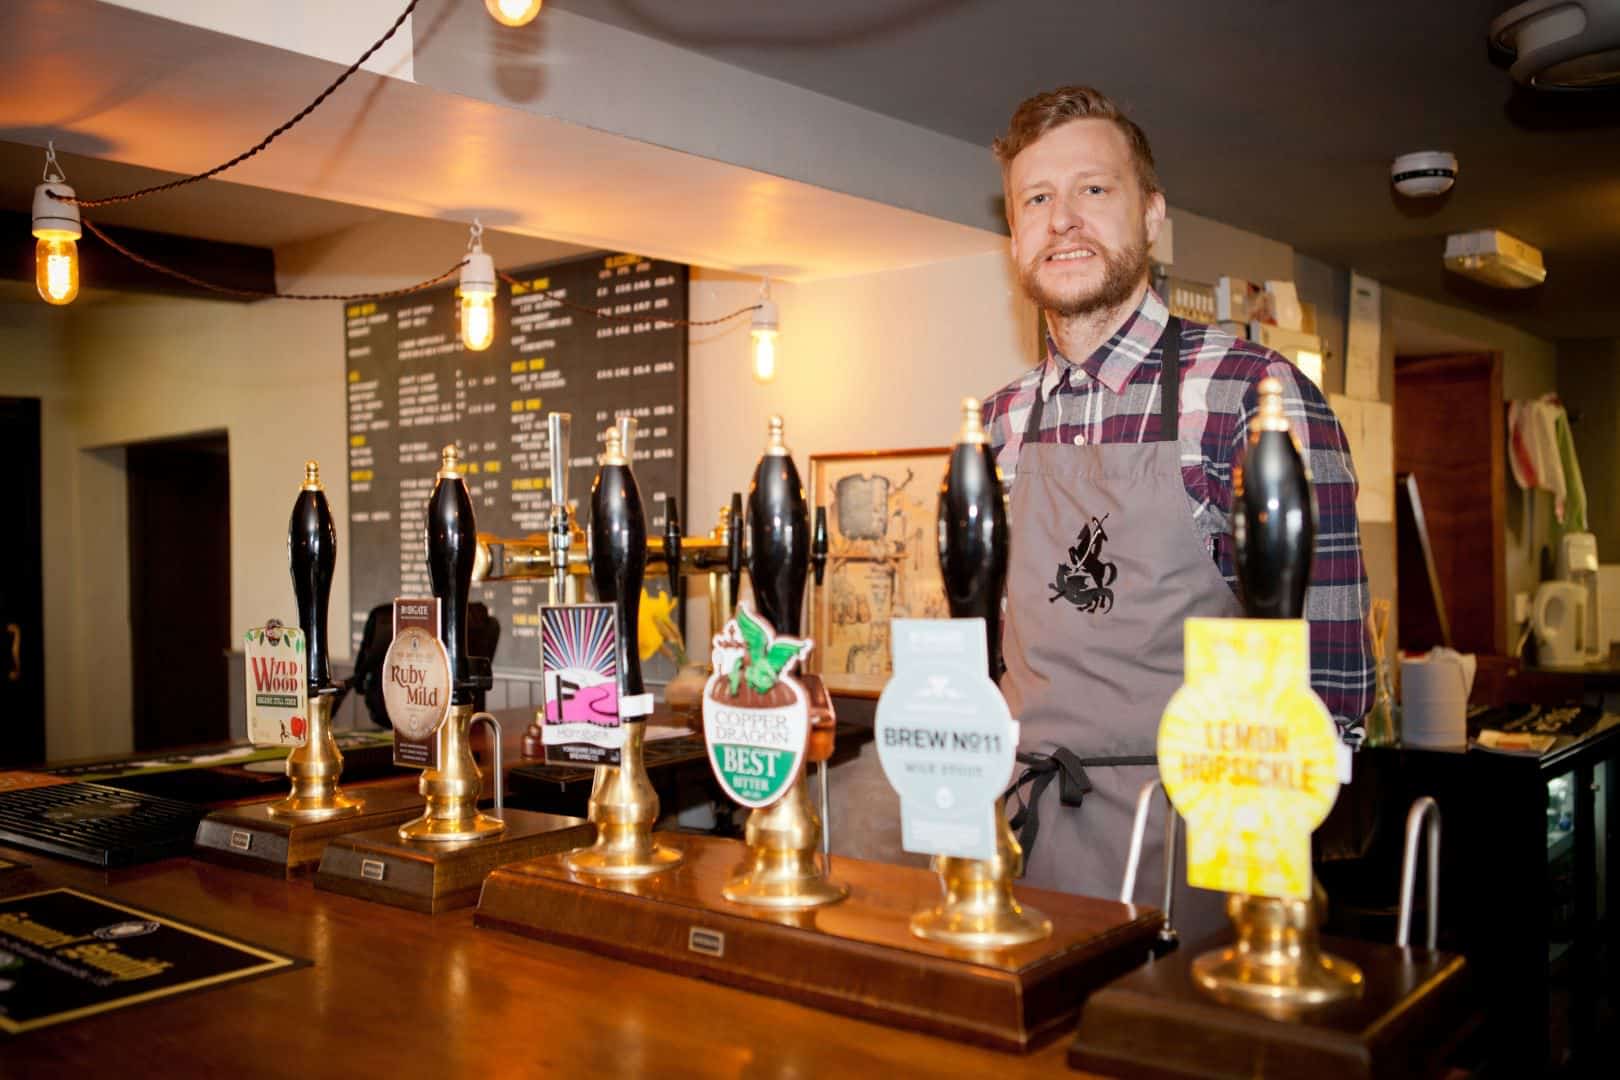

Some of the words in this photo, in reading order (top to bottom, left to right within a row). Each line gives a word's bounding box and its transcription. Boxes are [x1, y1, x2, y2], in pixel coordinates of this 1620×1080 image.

[391, 664, 426, 688] Ruby
[406, 686, 438, 706] Mild
[715, 710, 787, 729] COPPER
[715, 726, 789, 745] DRAGON
[884, 727, 948, 749] BREW
[1204, 720, 1288, 751] LEMON
[723, 746, 781, 777] BEST
